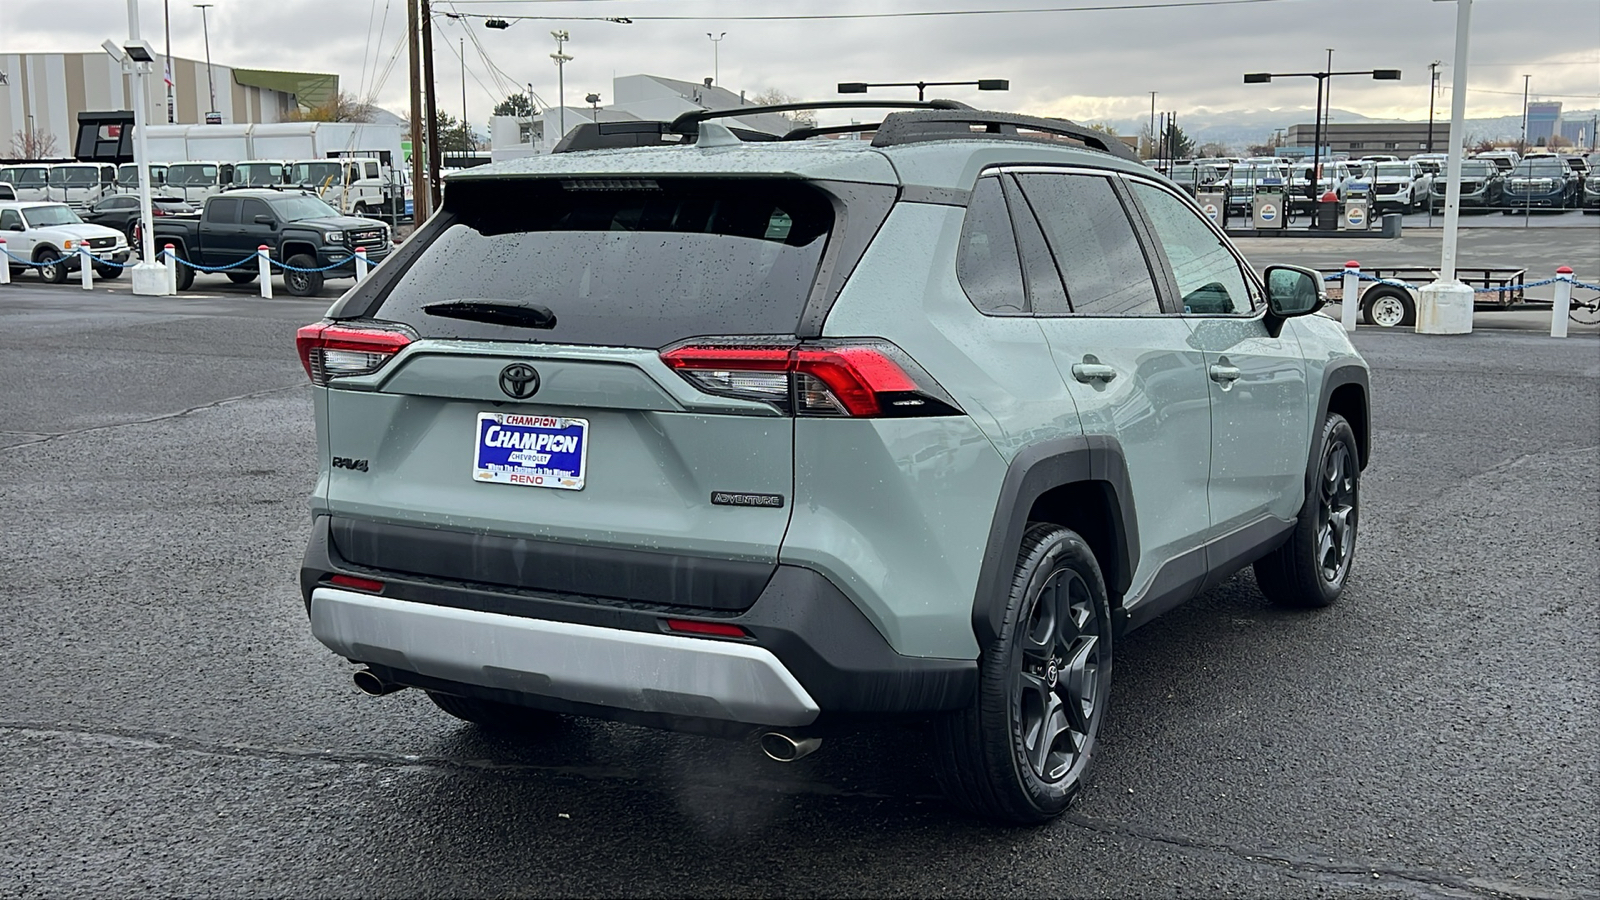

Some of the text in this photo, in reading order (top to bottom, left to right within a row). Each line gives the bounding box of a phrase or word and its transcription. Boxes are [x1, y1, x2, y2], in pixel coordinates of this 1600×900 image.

[506, 415, 557, 427] CHAMPION
[484, 425, 578, 453] CHAMPION
[332, 456, 368, 472] RAV4
[511, 453, 547, 462] CHEVROLET
[510, 474, 543, 485] RENO
[713, 492, 780, 506] ADVENTURE
[1012, 688, 1041, 799] HERCULES
